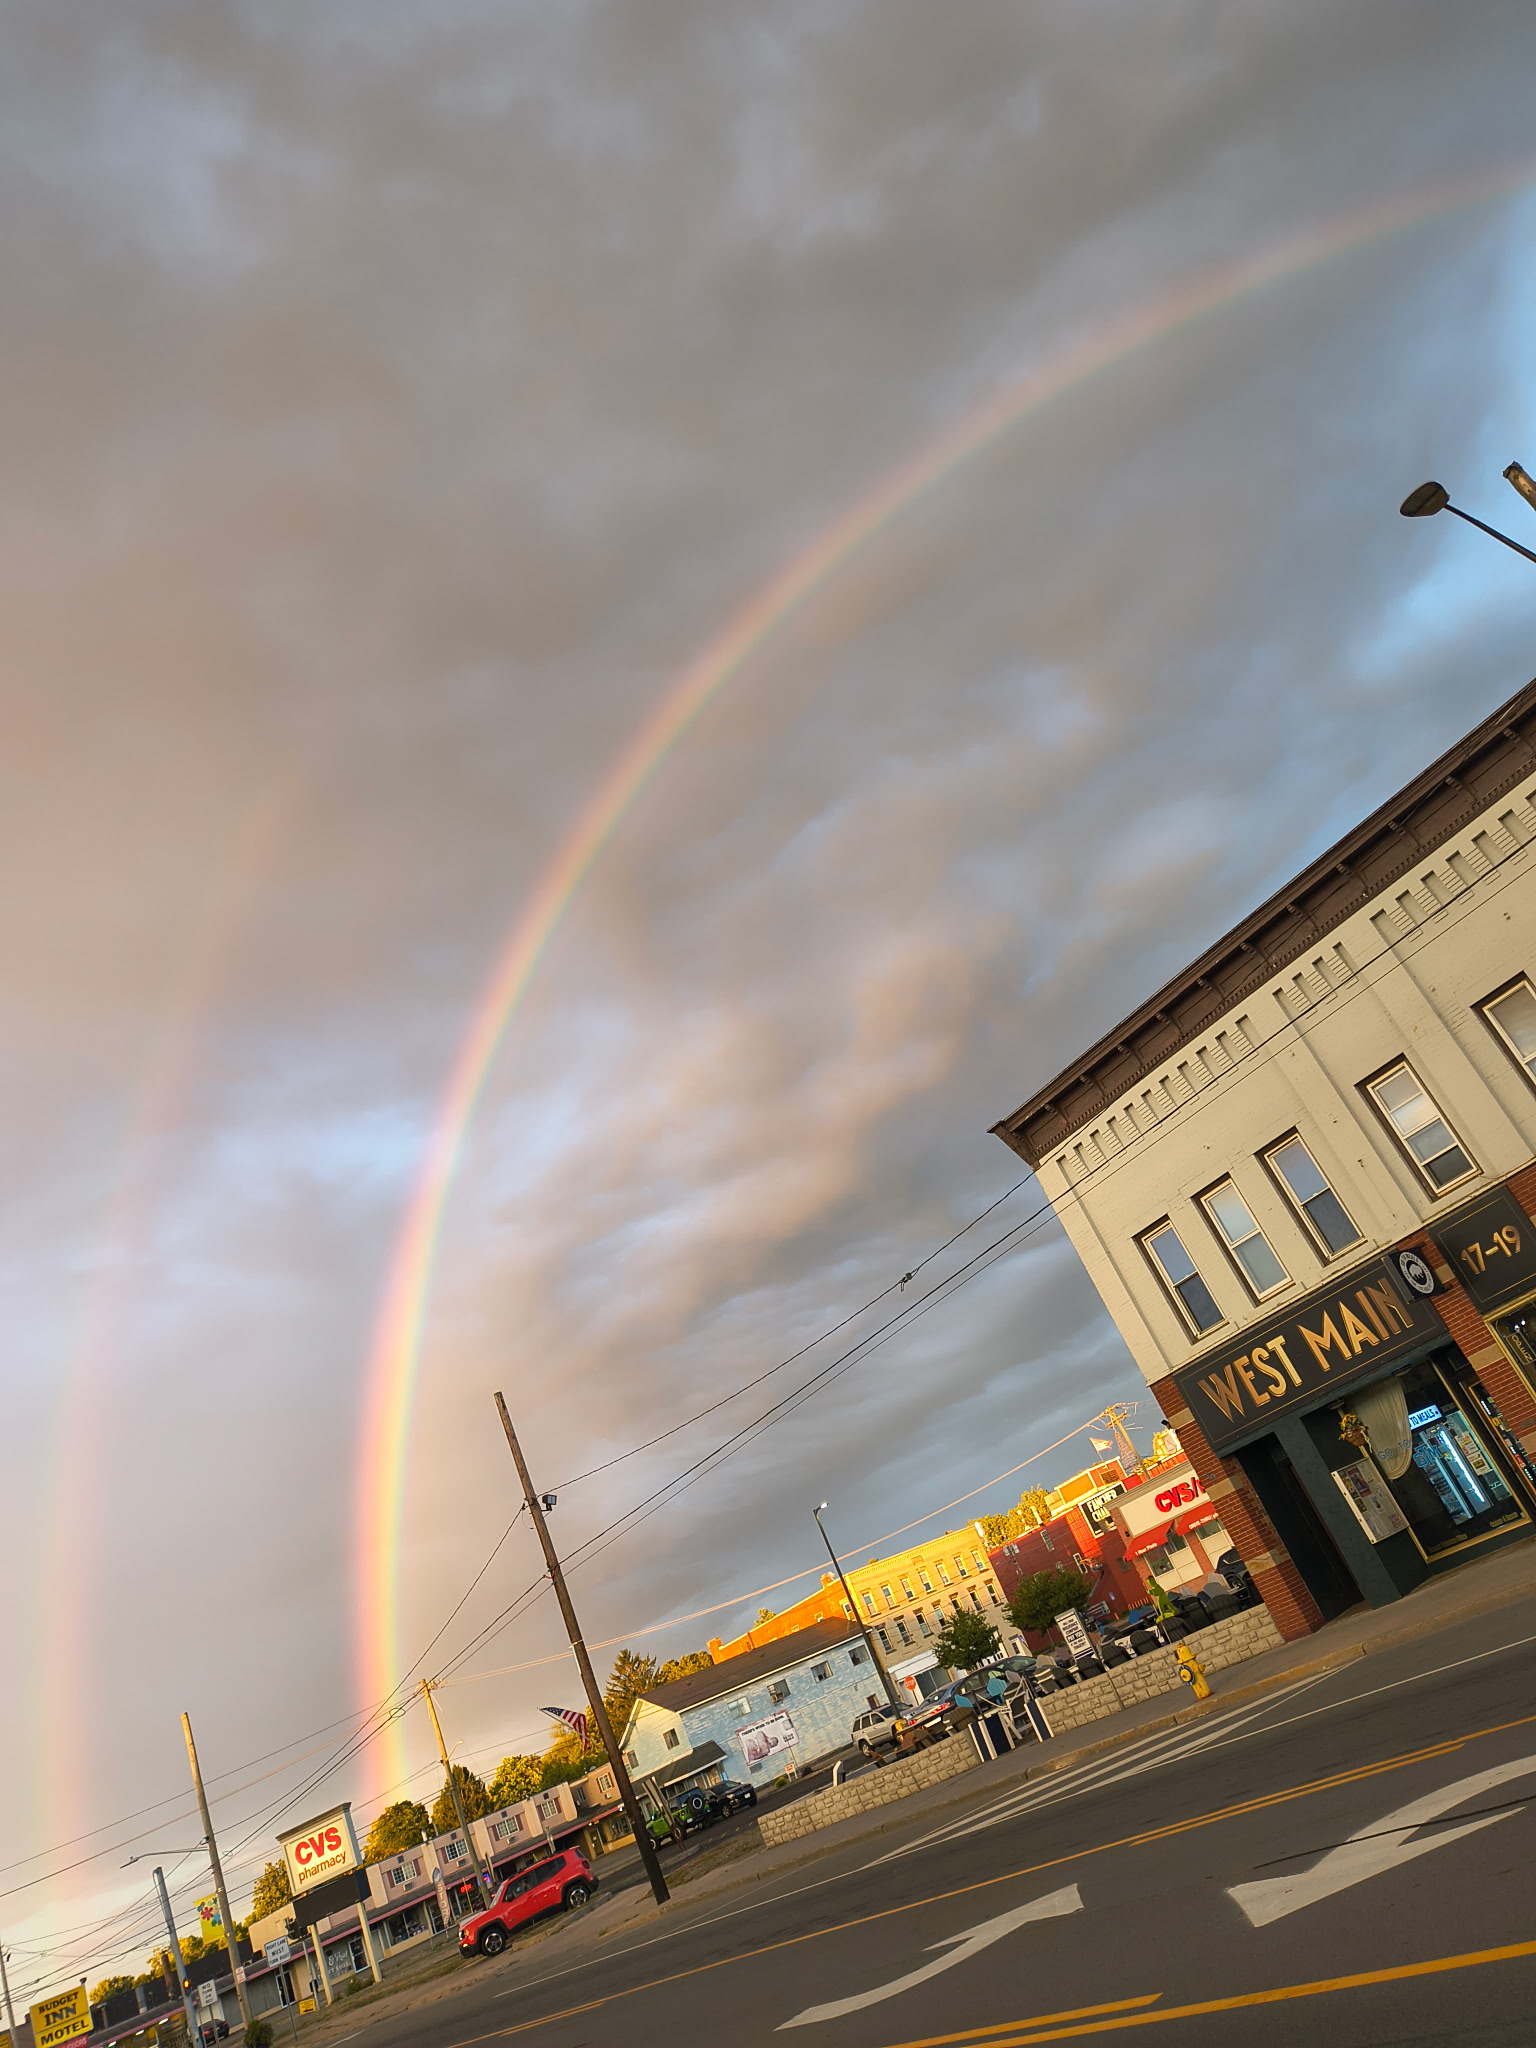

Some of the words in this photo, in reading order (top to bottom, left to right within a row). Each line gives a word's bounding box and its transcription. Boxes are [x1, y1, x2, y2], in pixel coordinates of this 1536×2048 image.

[1461, 1225, 1520, 1275] 17-19
[1197, 1335, 1303, 1424] WEST
[1297, 1277, 1414, 1373] MAIN
[1511, 1334, 1532, 1363] OPEN
[1417, 1408, 1436, 1423] MEALS
[1378, 1448, 1393, 1460] GO
[1396, 1439, 1411, 1450] TO
[1086, 1490, 1117, 1512] FANCHER
[295, 1827, 342, 1866] CVS
[298, 1851, 346, 1884] pharmacy
[271, 1947, 285, 1957] MUST
[276, 1938, 287, 1947] LANE
[279, 1953, 290, 1961] RIGHT
[38, 1992, 79, 2014] BUDGET
[44, 2003, 77, 2027] INN
[40, 2020, 89, 2046] MOTEL
